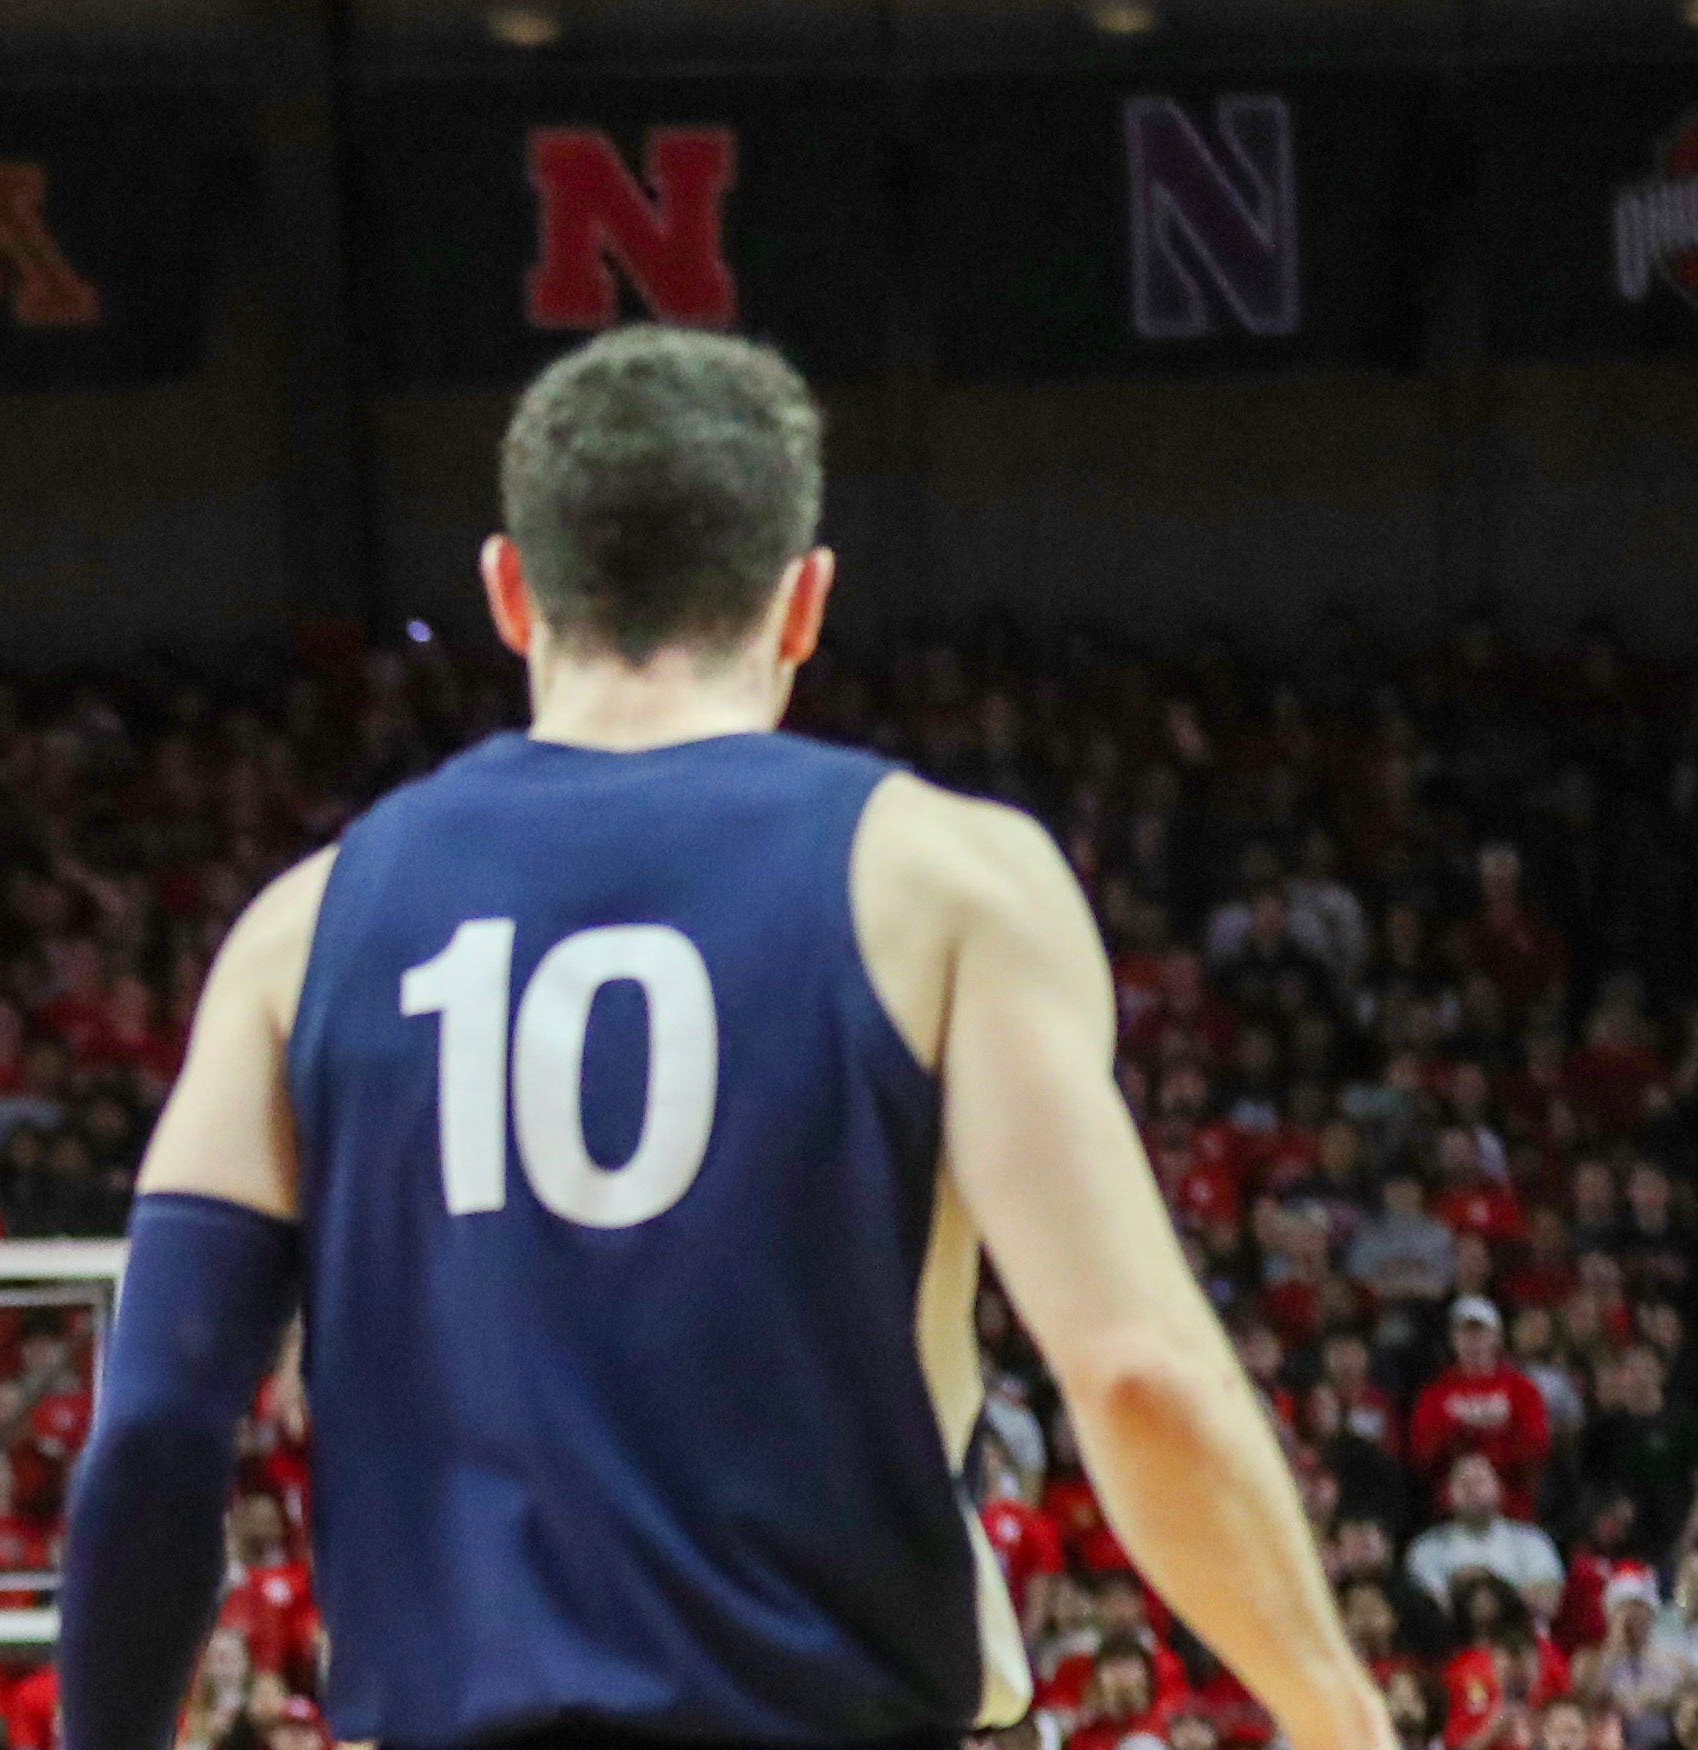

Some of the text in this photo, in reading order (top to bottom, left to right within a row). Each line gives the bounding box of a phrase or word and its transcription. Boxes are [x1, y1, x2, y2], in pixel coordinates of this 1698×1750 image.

[524, 124, 739, 331] N
[1122, 94, 1302, 340] N
[400, 915, 720, 1230] 10
